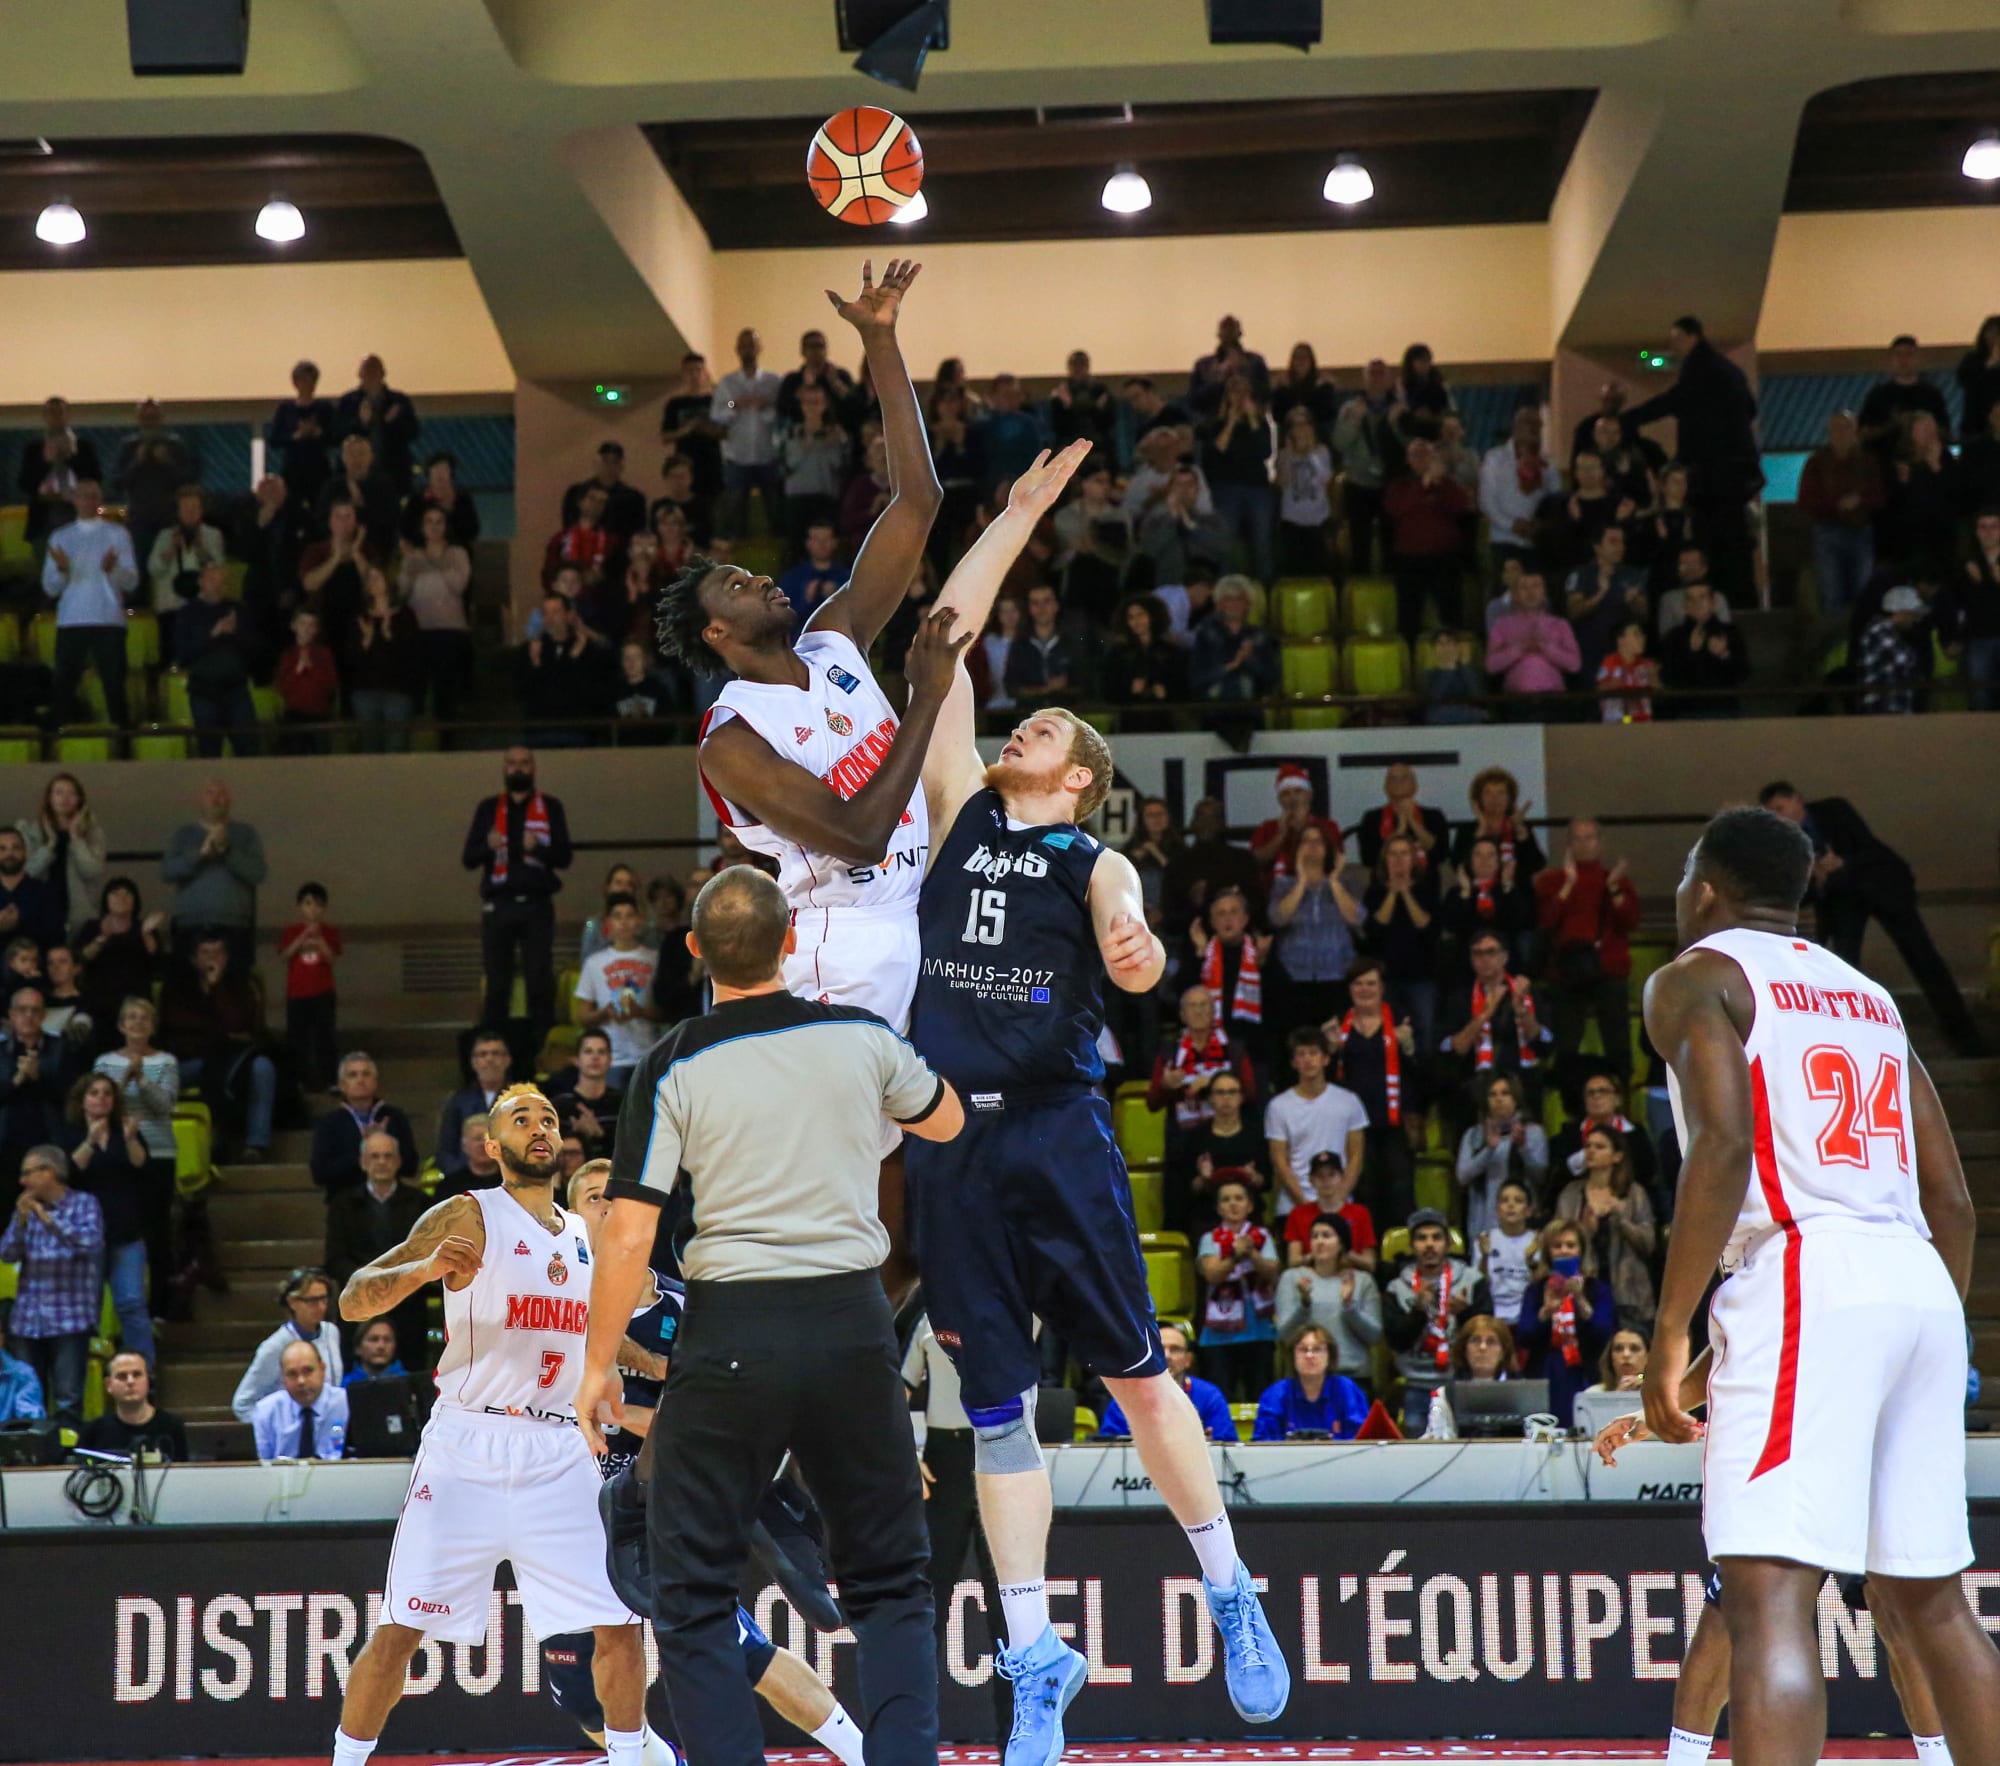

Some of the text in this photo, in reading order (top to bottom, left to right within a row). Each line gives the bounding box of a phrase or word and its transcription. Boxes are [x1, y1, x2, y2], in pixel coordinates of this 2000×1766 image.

[961, 888, 1007, 946] 15
[950, 980, 1029, 993] EUROPEAN CAPITAL
[976, 991, 1029, 1002] OF CULTURE
[1802, 1043, 1909, 1177] 24
[505, 1294, 589, 1336] MONAC
[538, 1351, 565, 1389] 7
[1638, 1483, 1703, 1500] MART
[1011, 1585, 1044, 1596] SPALD
